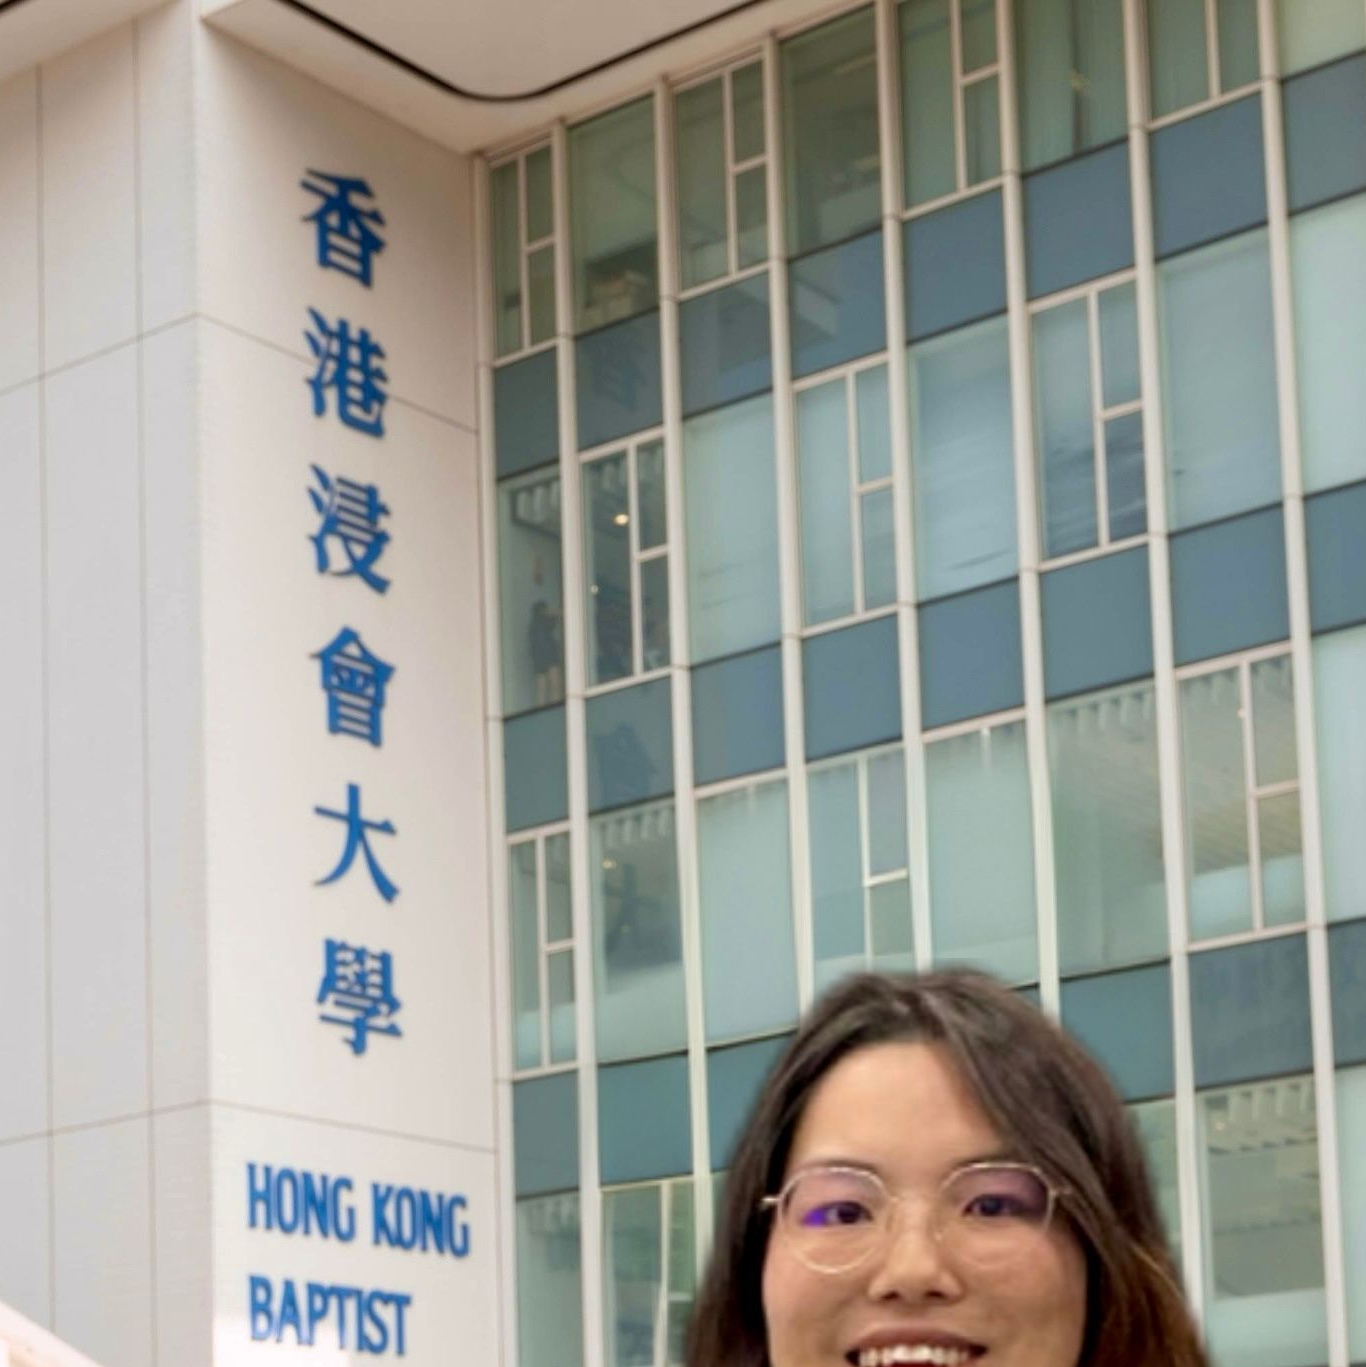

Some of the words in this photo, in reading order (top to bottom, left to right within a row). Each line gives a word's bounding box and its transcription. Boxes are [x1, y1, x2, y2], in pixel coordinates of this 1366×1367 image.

[299, 168, 404, 1056] 香港浸會大學
[246, 1162, 356, 1243] HONG
[371, 1182, 471, 1258] KONG
[248, 1274, 412, 1356] BAPTIST
